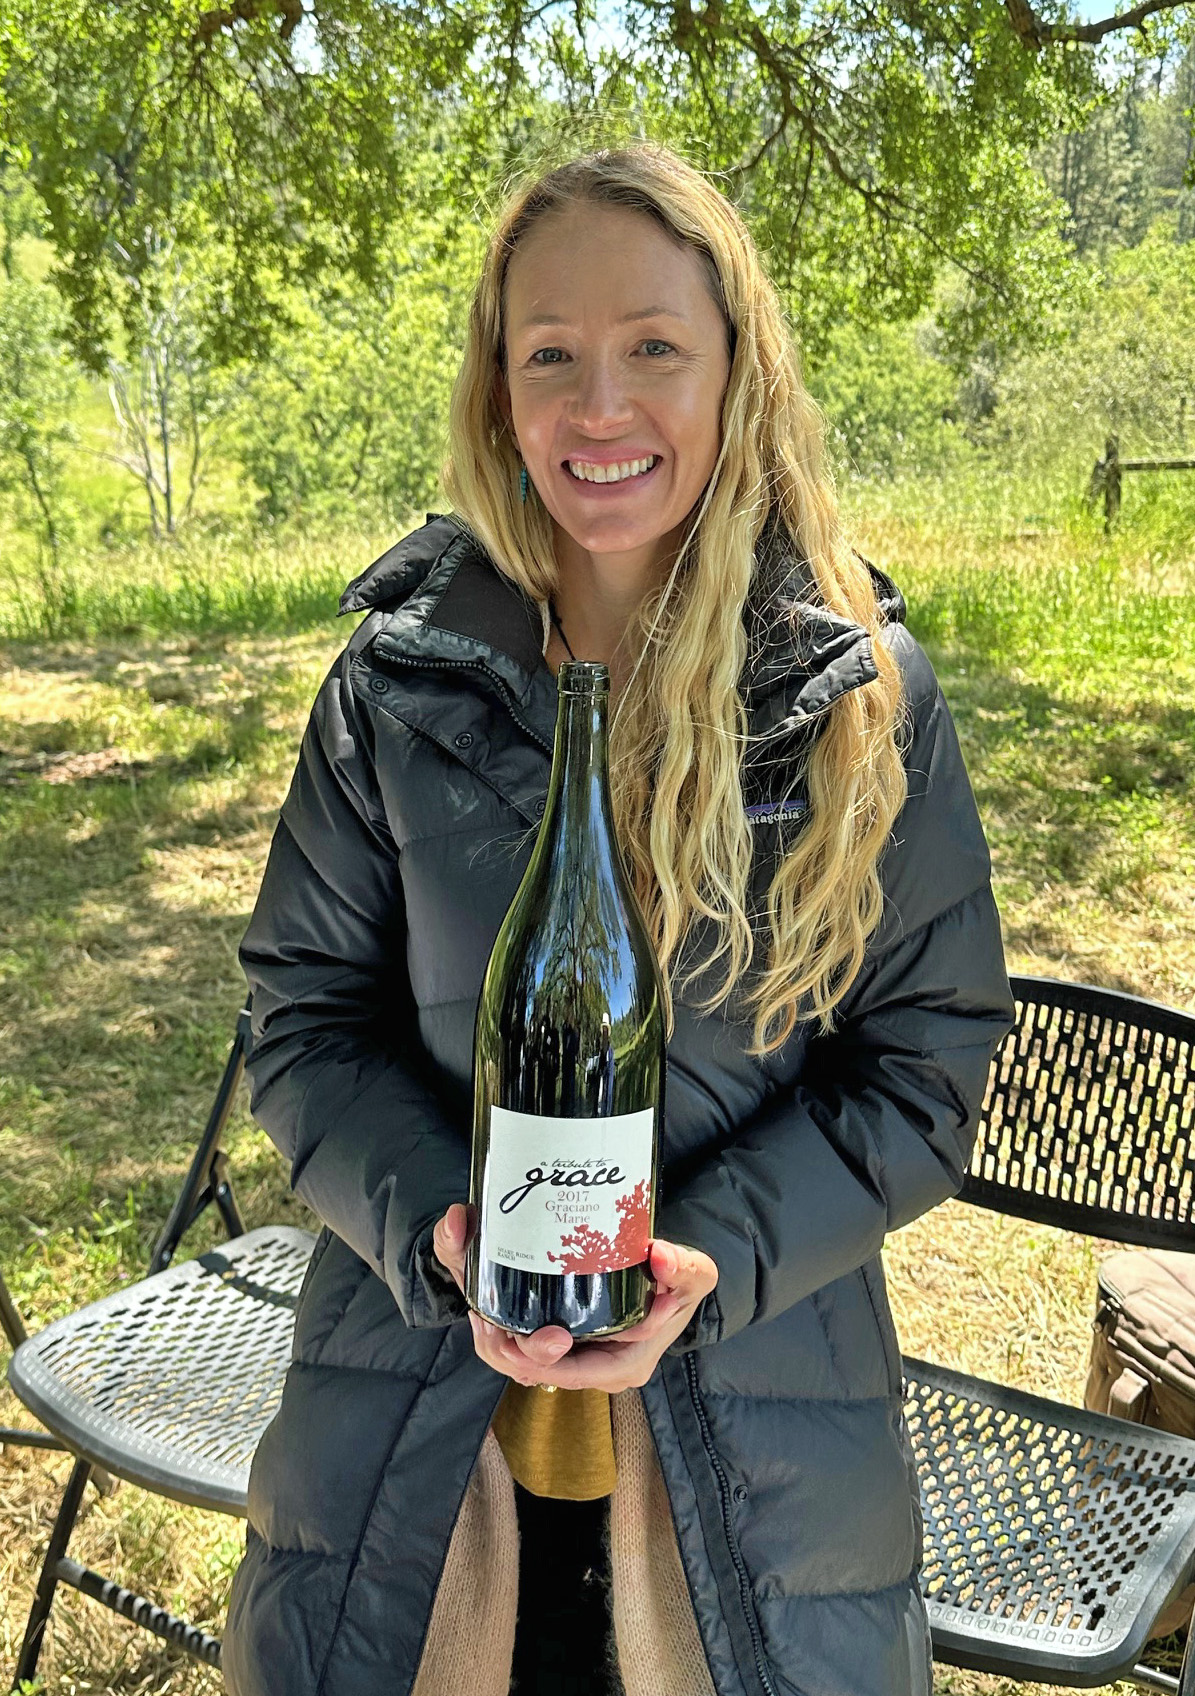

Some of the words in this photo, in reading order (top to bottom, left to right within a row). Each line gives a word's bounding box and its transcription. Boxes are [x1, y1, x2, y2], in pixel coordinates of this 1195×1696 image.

[748, 810, 800, 825] atagonia
[552, 1158, 594, 1168] tribute
[595, 1157, 614, 1167] to
[499, 1166, 627, 1215] grace
[557, 1190, 590, 1202] 2017
[545, 1200, 600, 1213] Graciano
[554, 1212, 591, 1224] Marie
[515, 1251, 536, 1261] RIDGE
